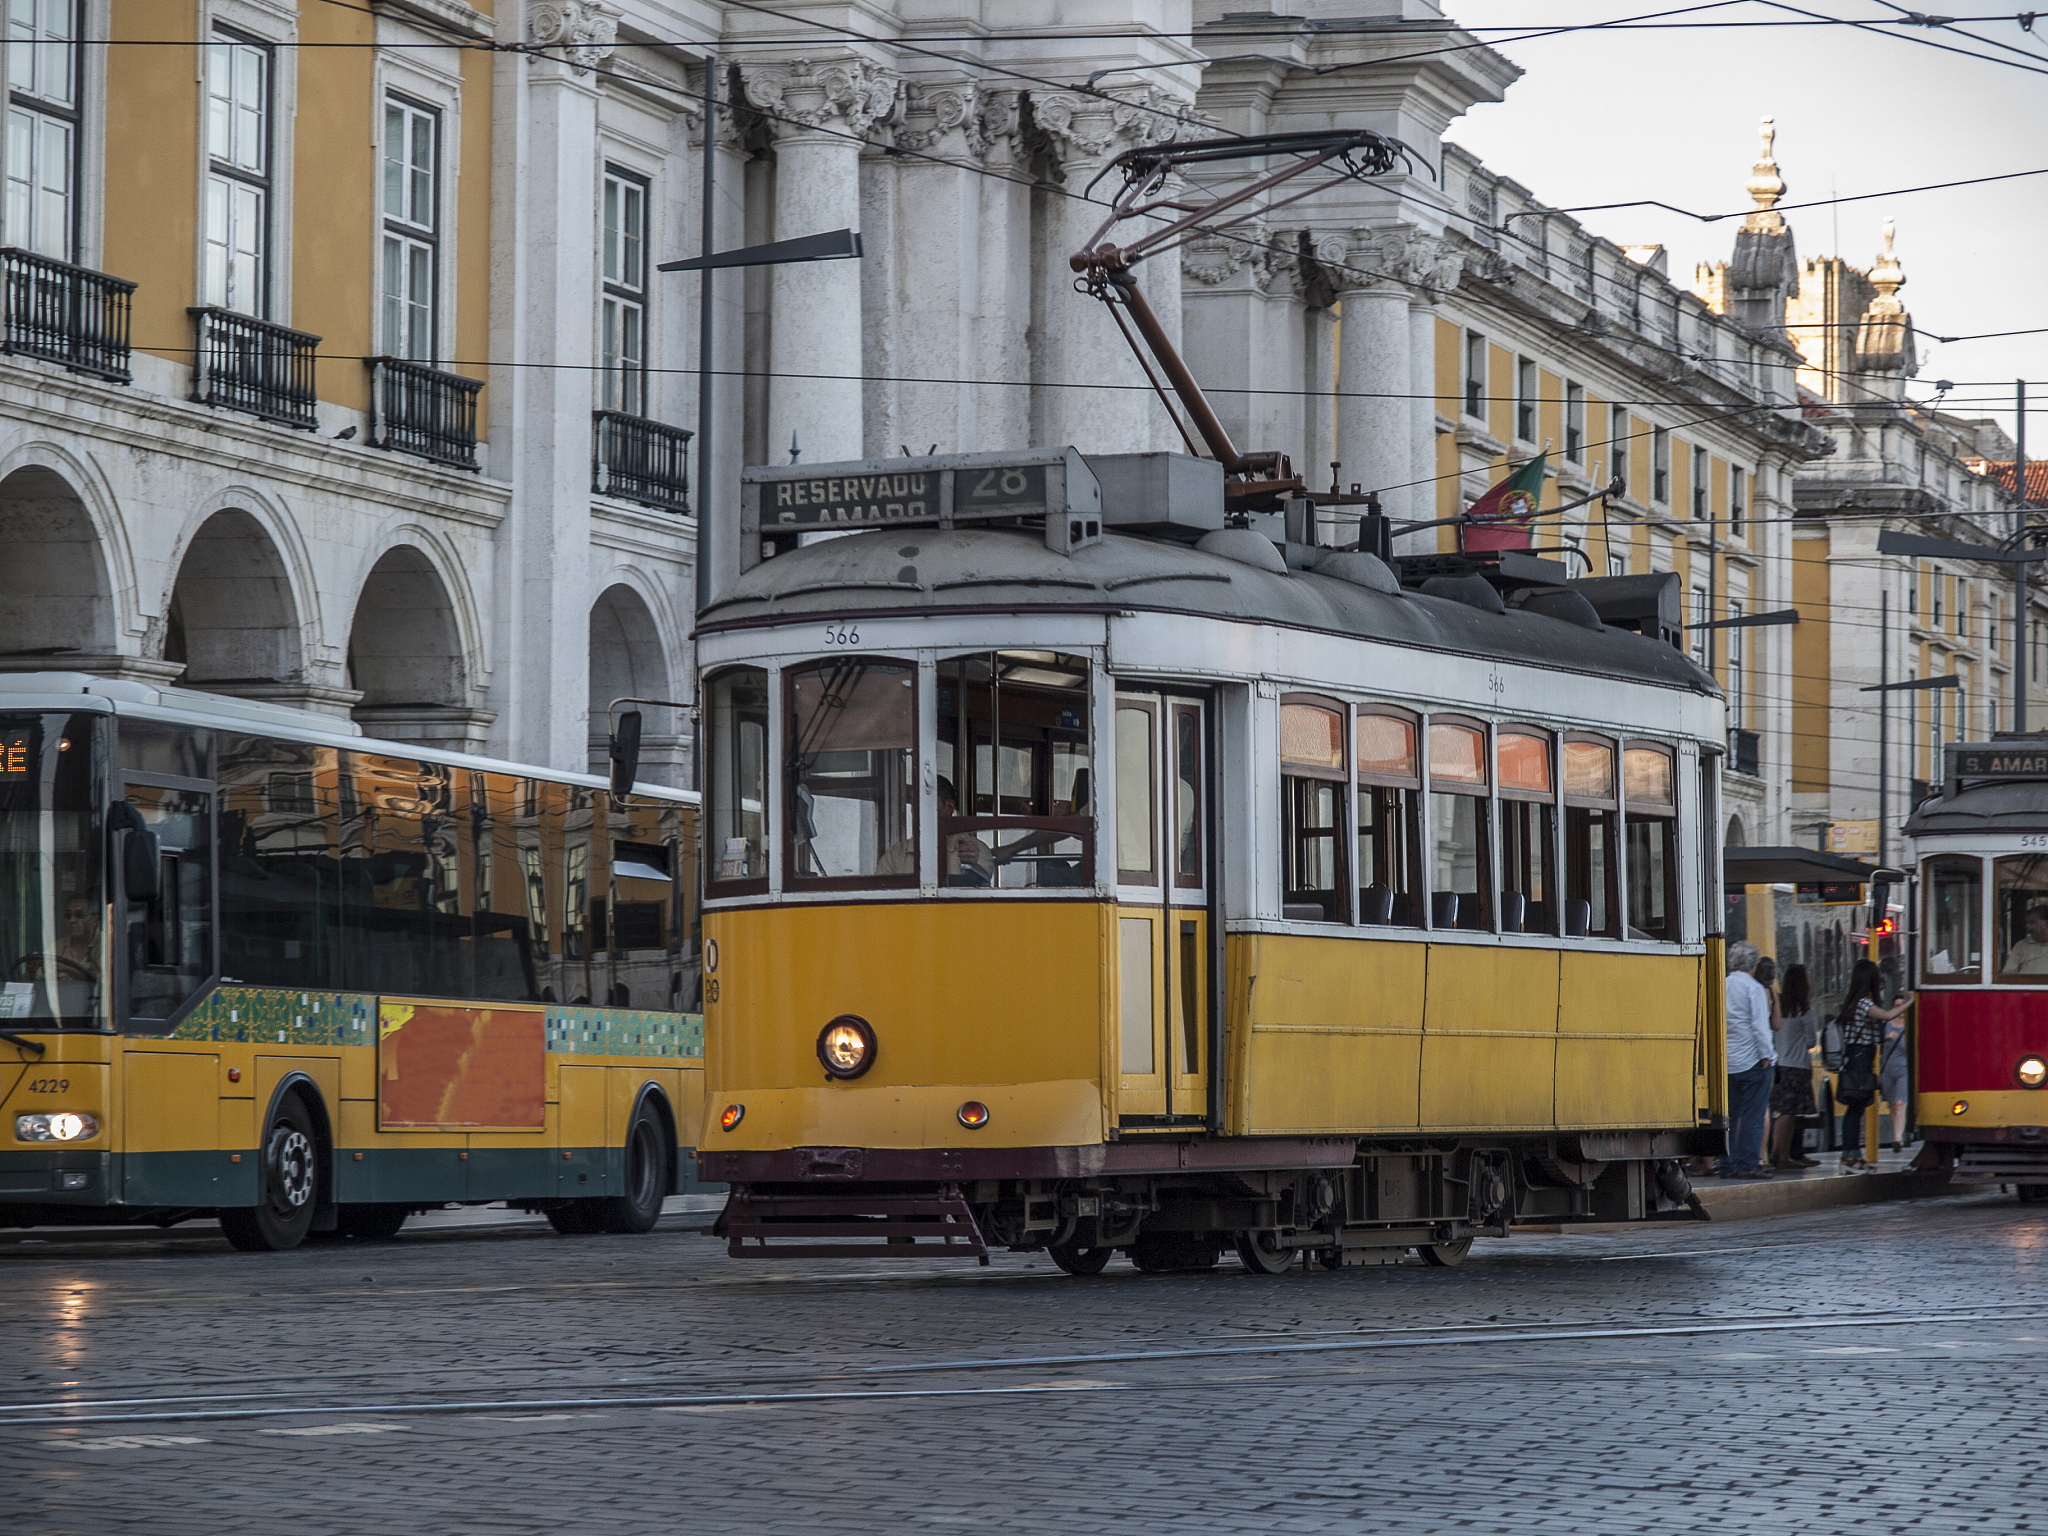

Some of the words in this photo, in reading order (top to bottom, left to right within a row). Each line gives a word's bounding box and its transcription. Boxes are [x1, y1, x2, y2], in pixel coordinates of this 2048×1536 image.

[776, 473, 926, 507] RESERVADO
[825, 625, 860, 645] 566
[1488, 673, 1505, 693] 566
[0, 740, 27, 772] É
[2020, 835, 2048, 848] 545
[28, 1079, 70, 1094] 4229
